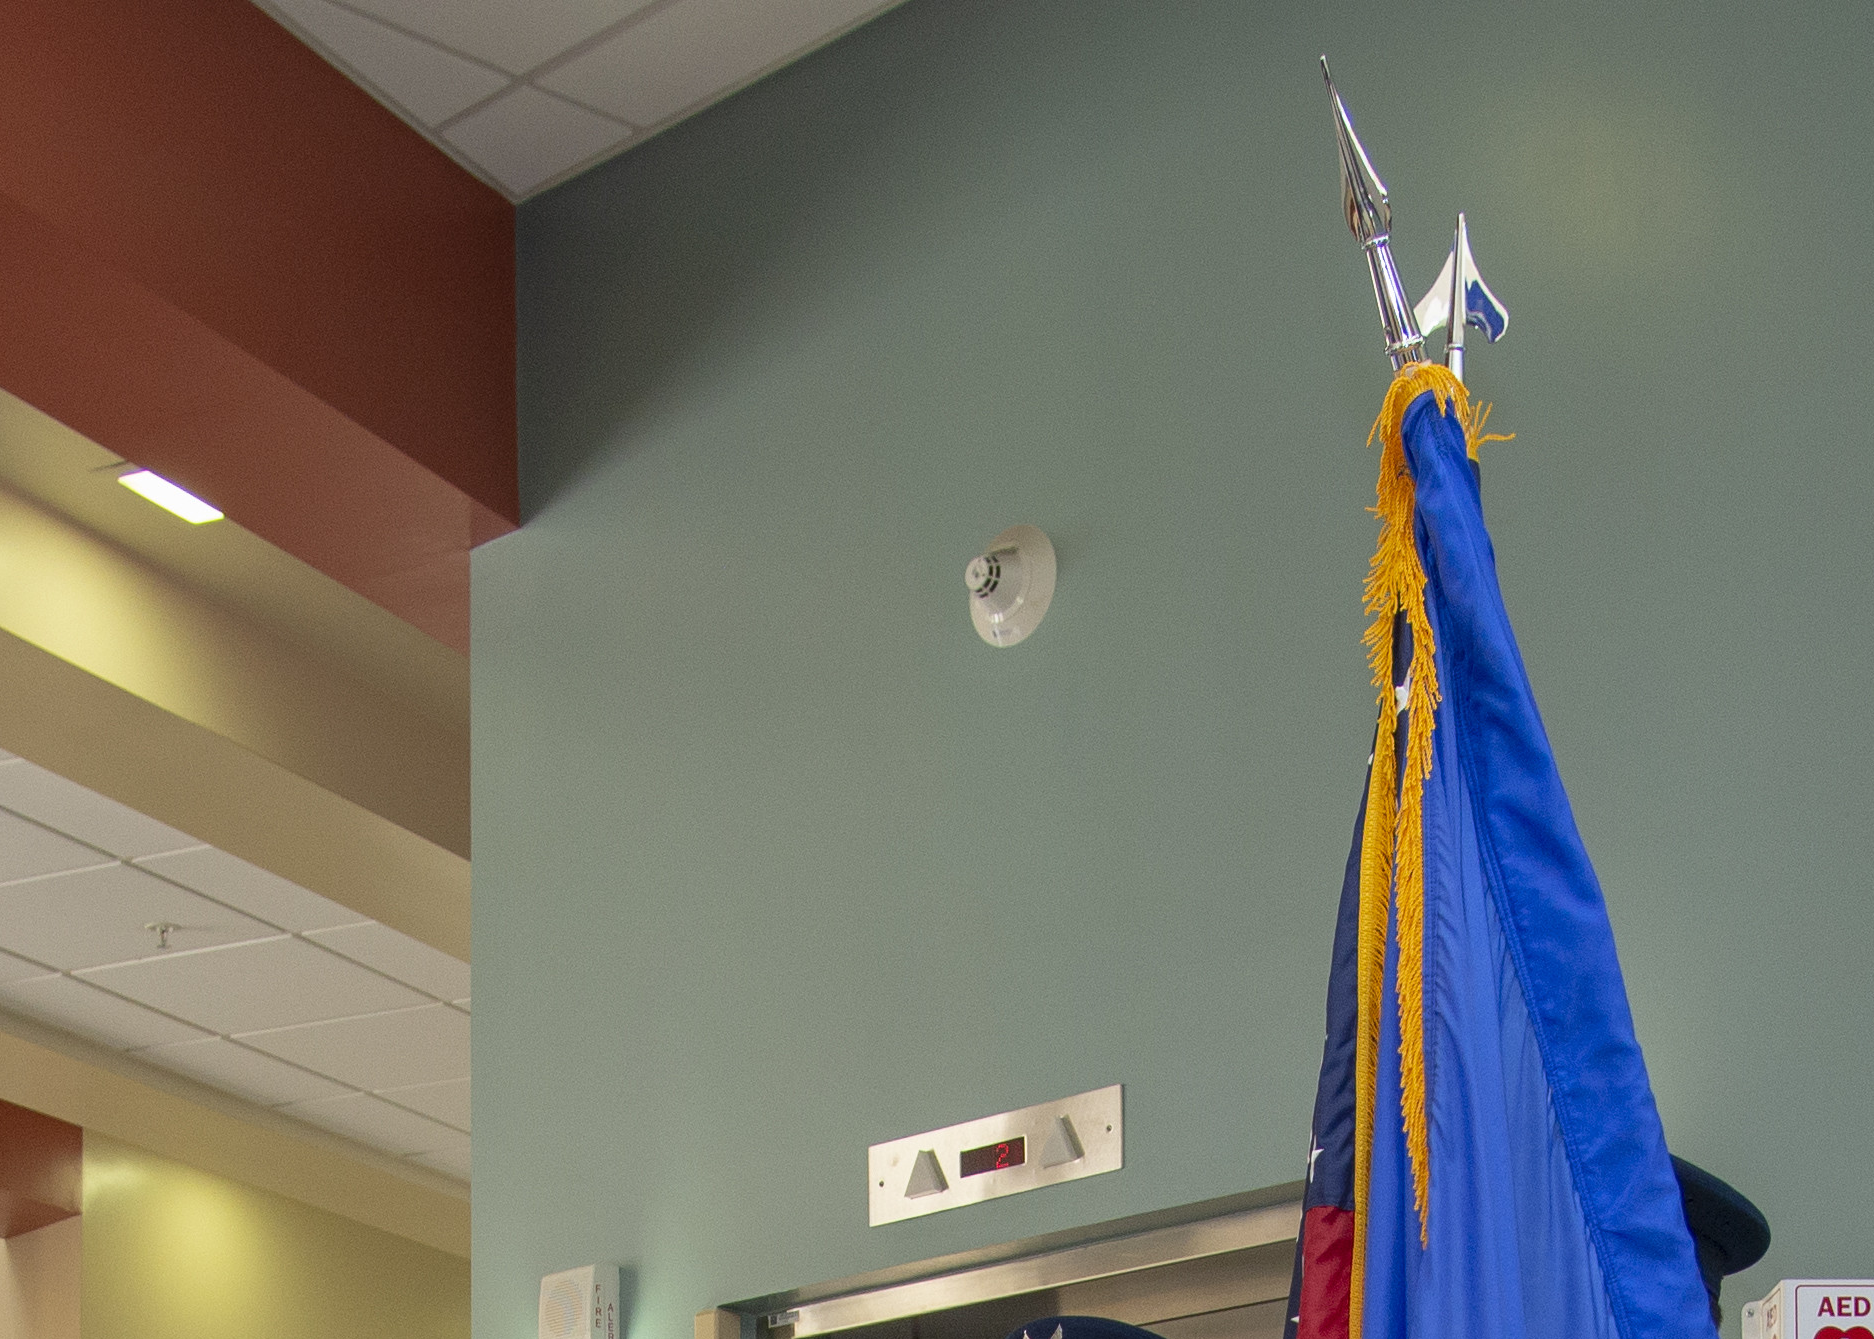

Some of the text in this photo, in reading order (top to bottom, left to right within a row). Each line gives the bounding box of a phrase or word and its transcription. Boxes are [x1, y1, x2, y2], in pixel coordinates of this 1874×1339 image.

[995, 1143, 1009, 1169] 2
[594, 1284, 602, 1329] FIRE
[1817, 1296, 1872, 1318] AED
